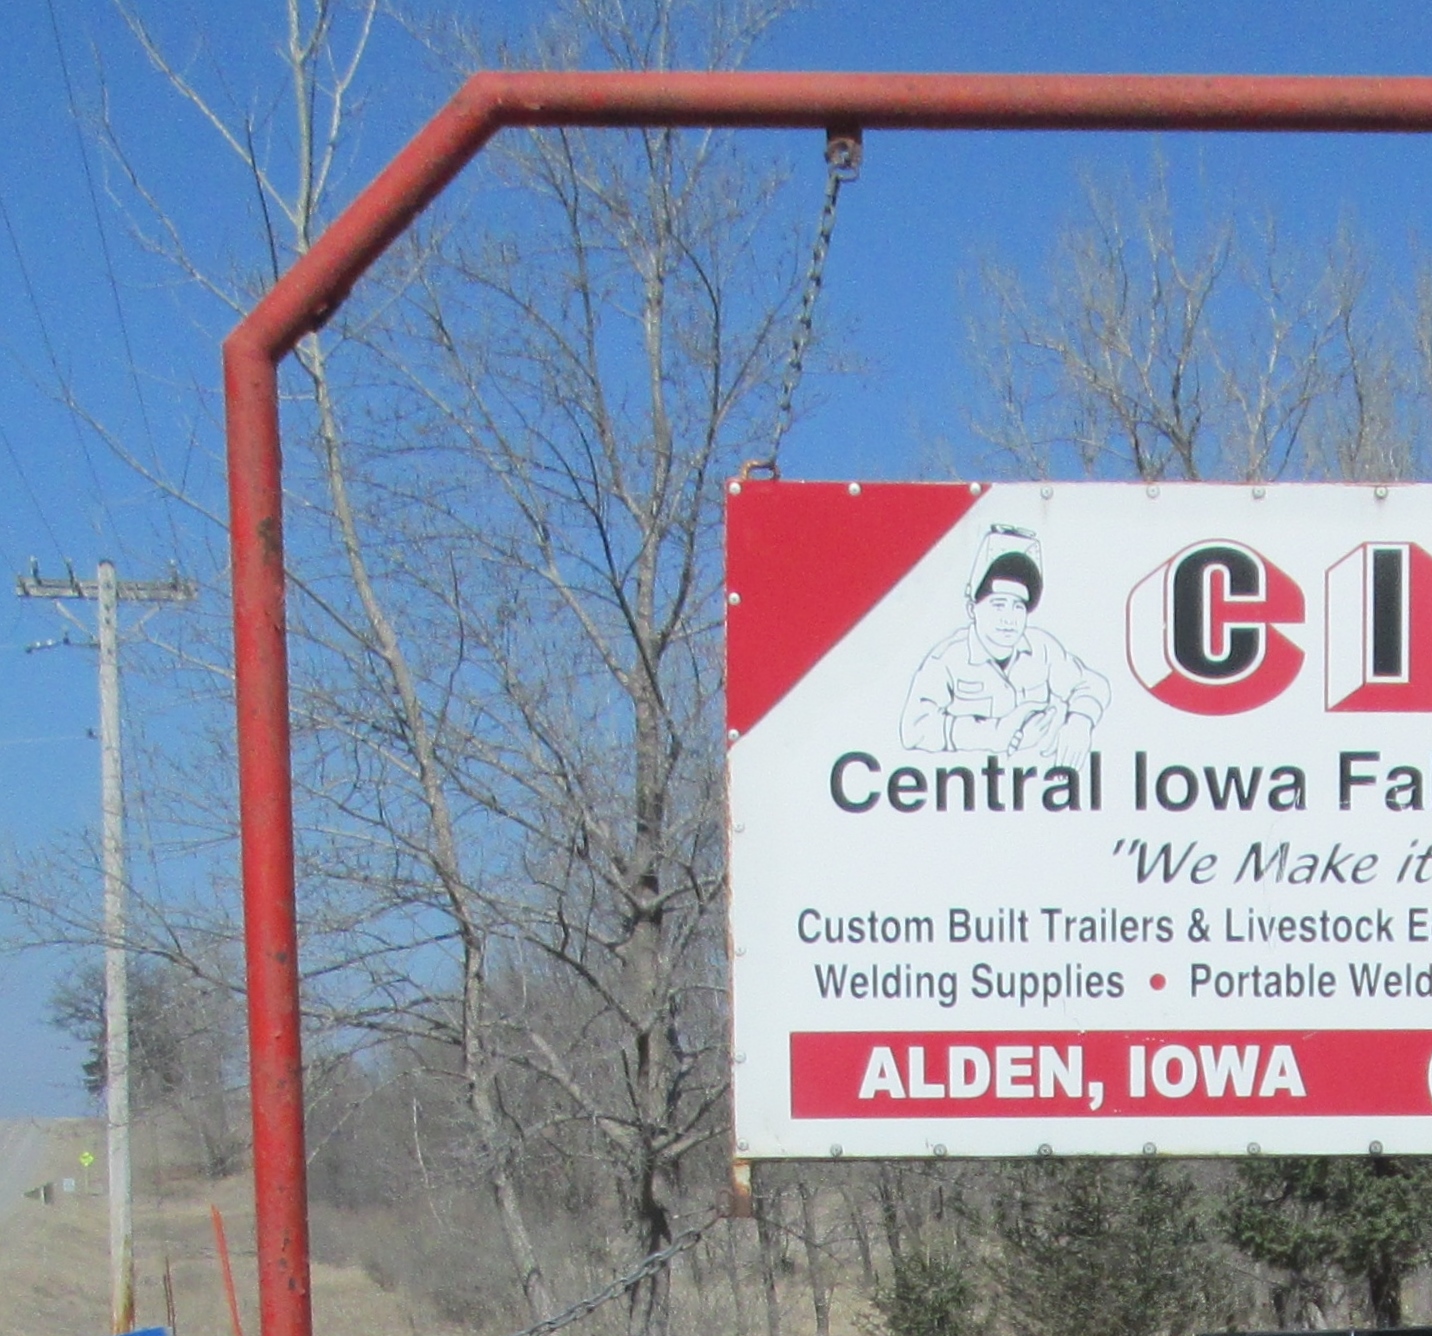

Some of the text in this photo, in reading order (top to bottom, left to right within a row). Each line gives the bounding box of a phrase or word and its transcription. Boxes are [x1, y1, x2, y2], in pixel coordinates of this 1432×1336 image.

[829, 751, 1101, 813] Central
[1134, 751, 1307, 813] Iowa
[1236, 841, 1379, 884] Make
[798, 908, 933, 943] Custom
[949, 908, 1028, 943] Built
[1041, 908, 1174, 943] Trailers
[1187, 908, 1210, 943] &
[1225, 908, 1394, 943] Livestock
[814, 963, 957, 1007] Welding
[971, 962, 1124, 1006] Supplies
[1190, 963, 1336, 998] Portable
[858, 1045, 1104, 1111] ALDEN,
[1129, 1044, 1307, 1099] IOWA
